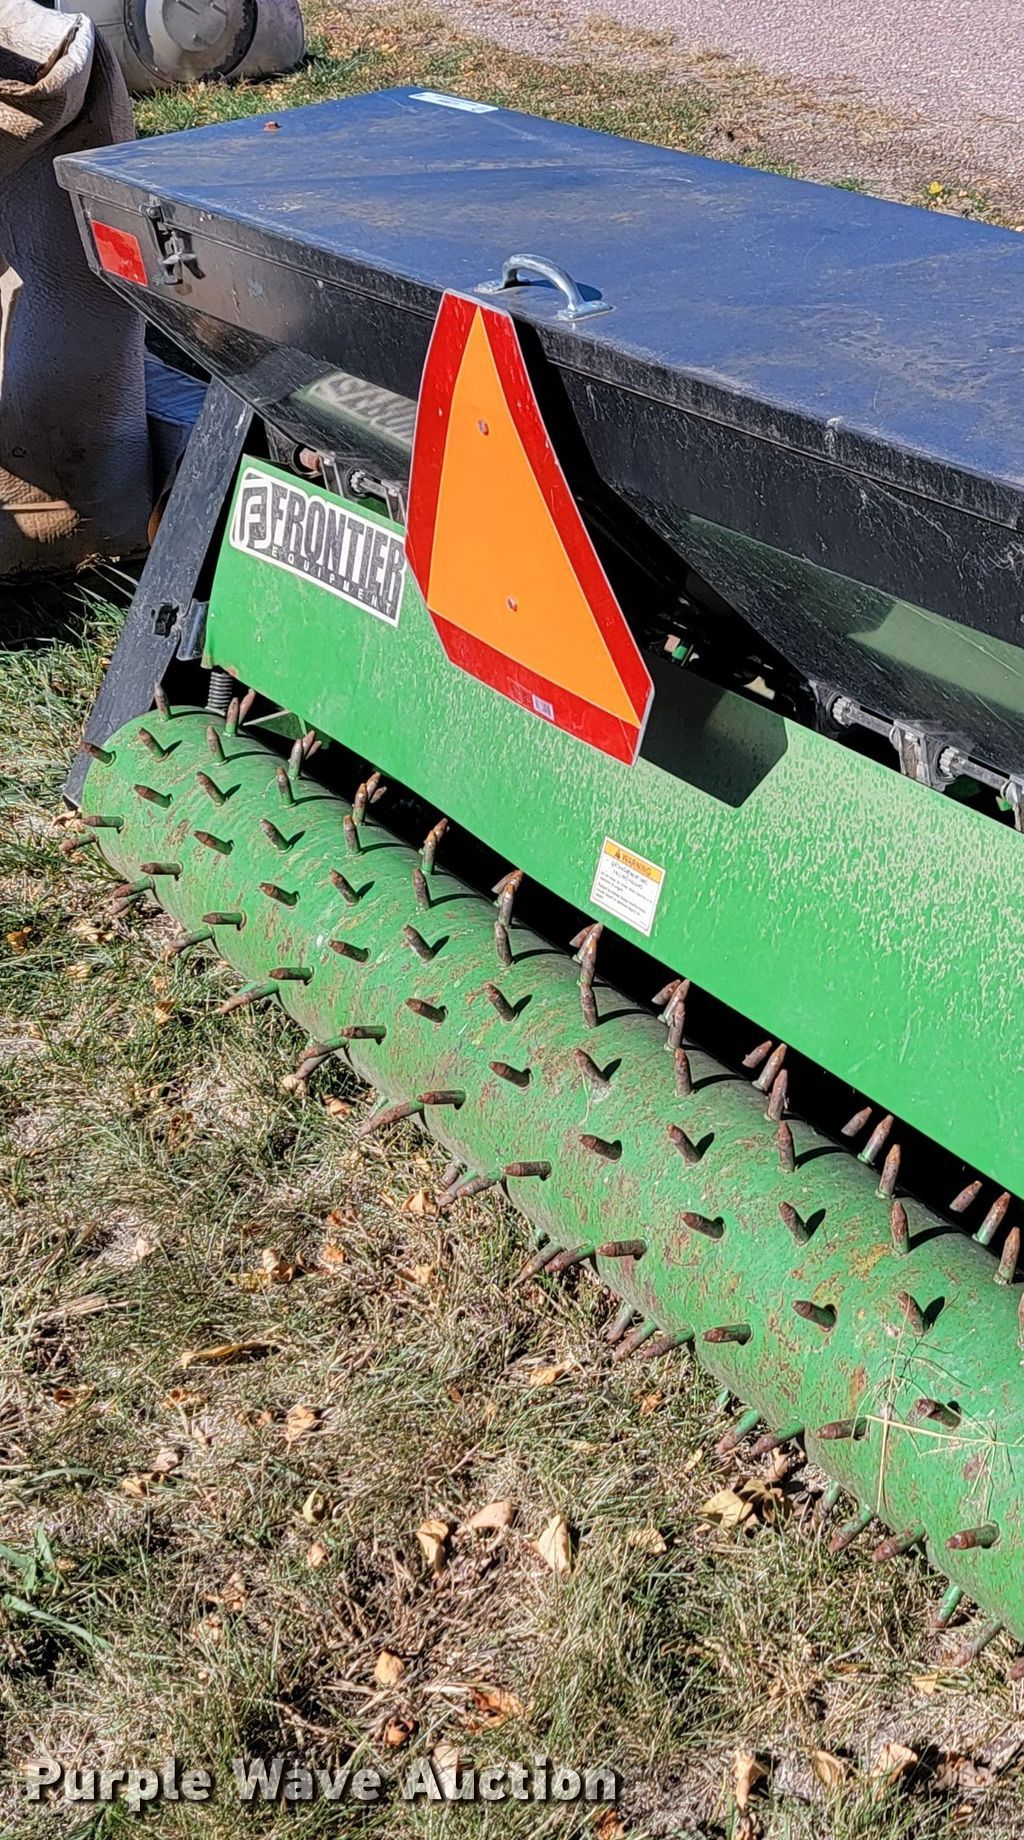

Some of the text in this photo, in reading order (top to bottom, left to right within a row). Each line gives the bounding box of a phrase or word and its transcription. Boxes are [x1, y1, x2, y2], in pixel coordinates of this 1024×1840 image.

[270, 482, 406, 603] FRONTIER
[271, 546, 394, 615] EQUIPMENT
[622, 853, 653, 877] WARNING
